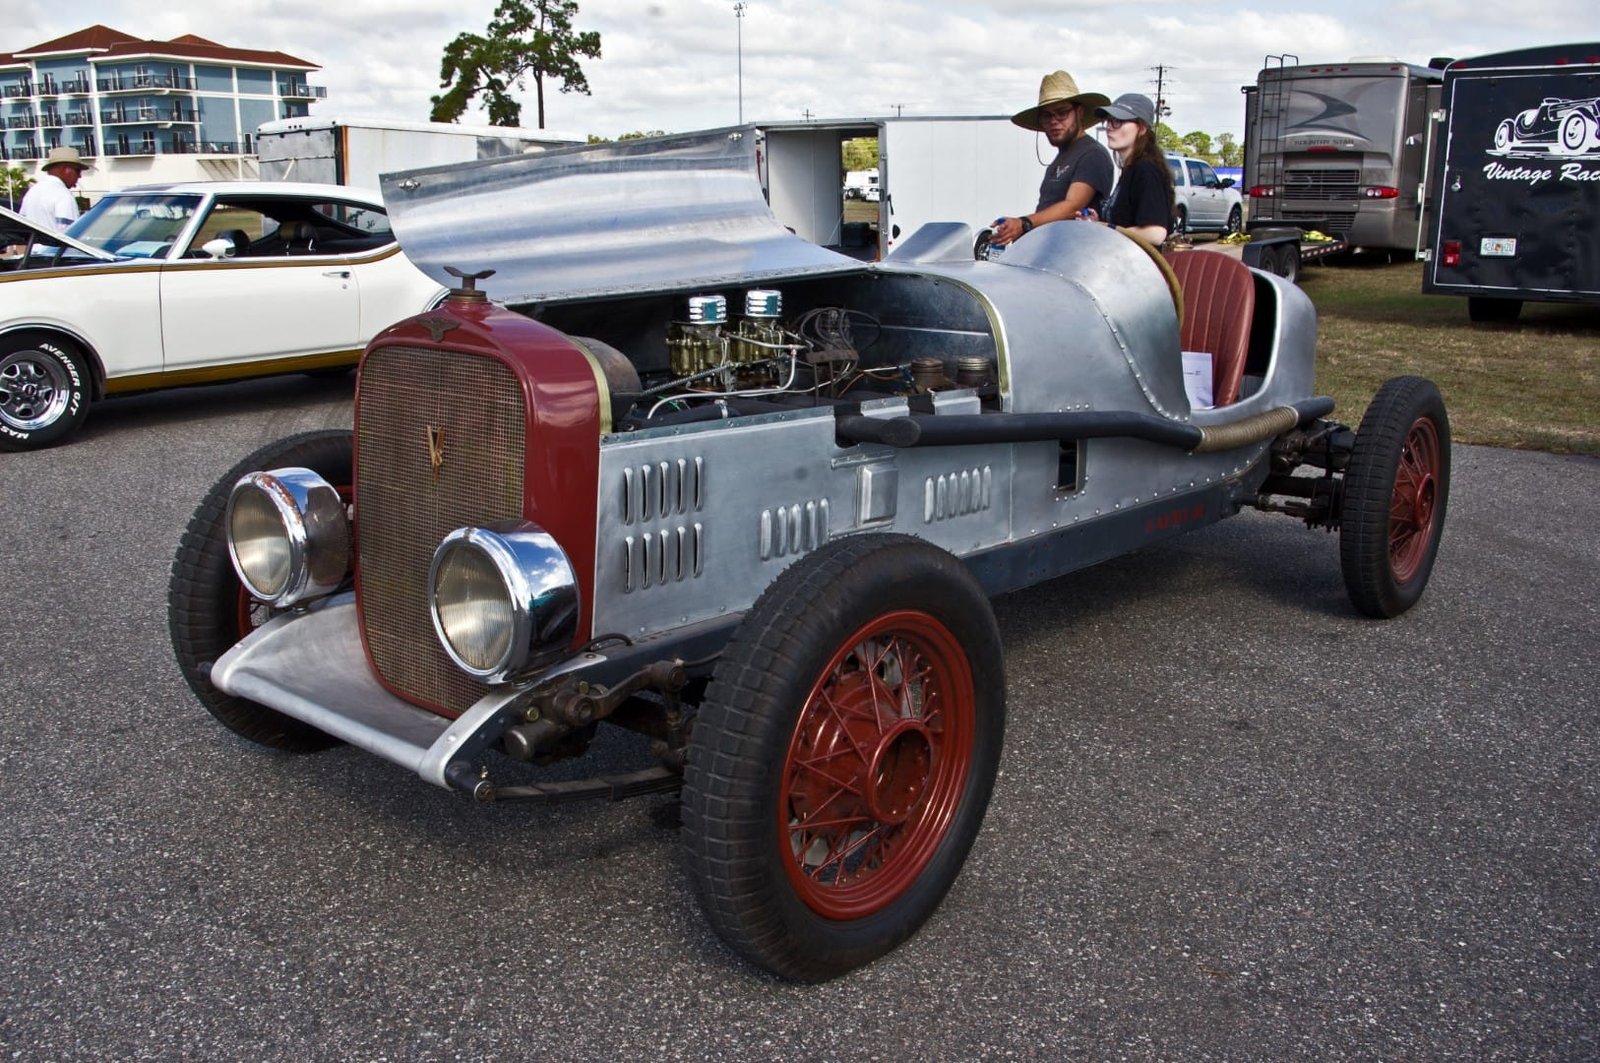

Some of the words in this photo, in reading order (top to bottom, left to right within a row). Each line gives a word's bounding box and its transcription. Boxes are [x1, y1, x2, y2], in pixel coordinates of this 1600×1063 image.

[1483, 161, 1552, 186] Vintage
[39, 343, 81, 387] AVENGER
[70, 391, 81, 414] G/T
[0, 422, 30, 440] MAS
